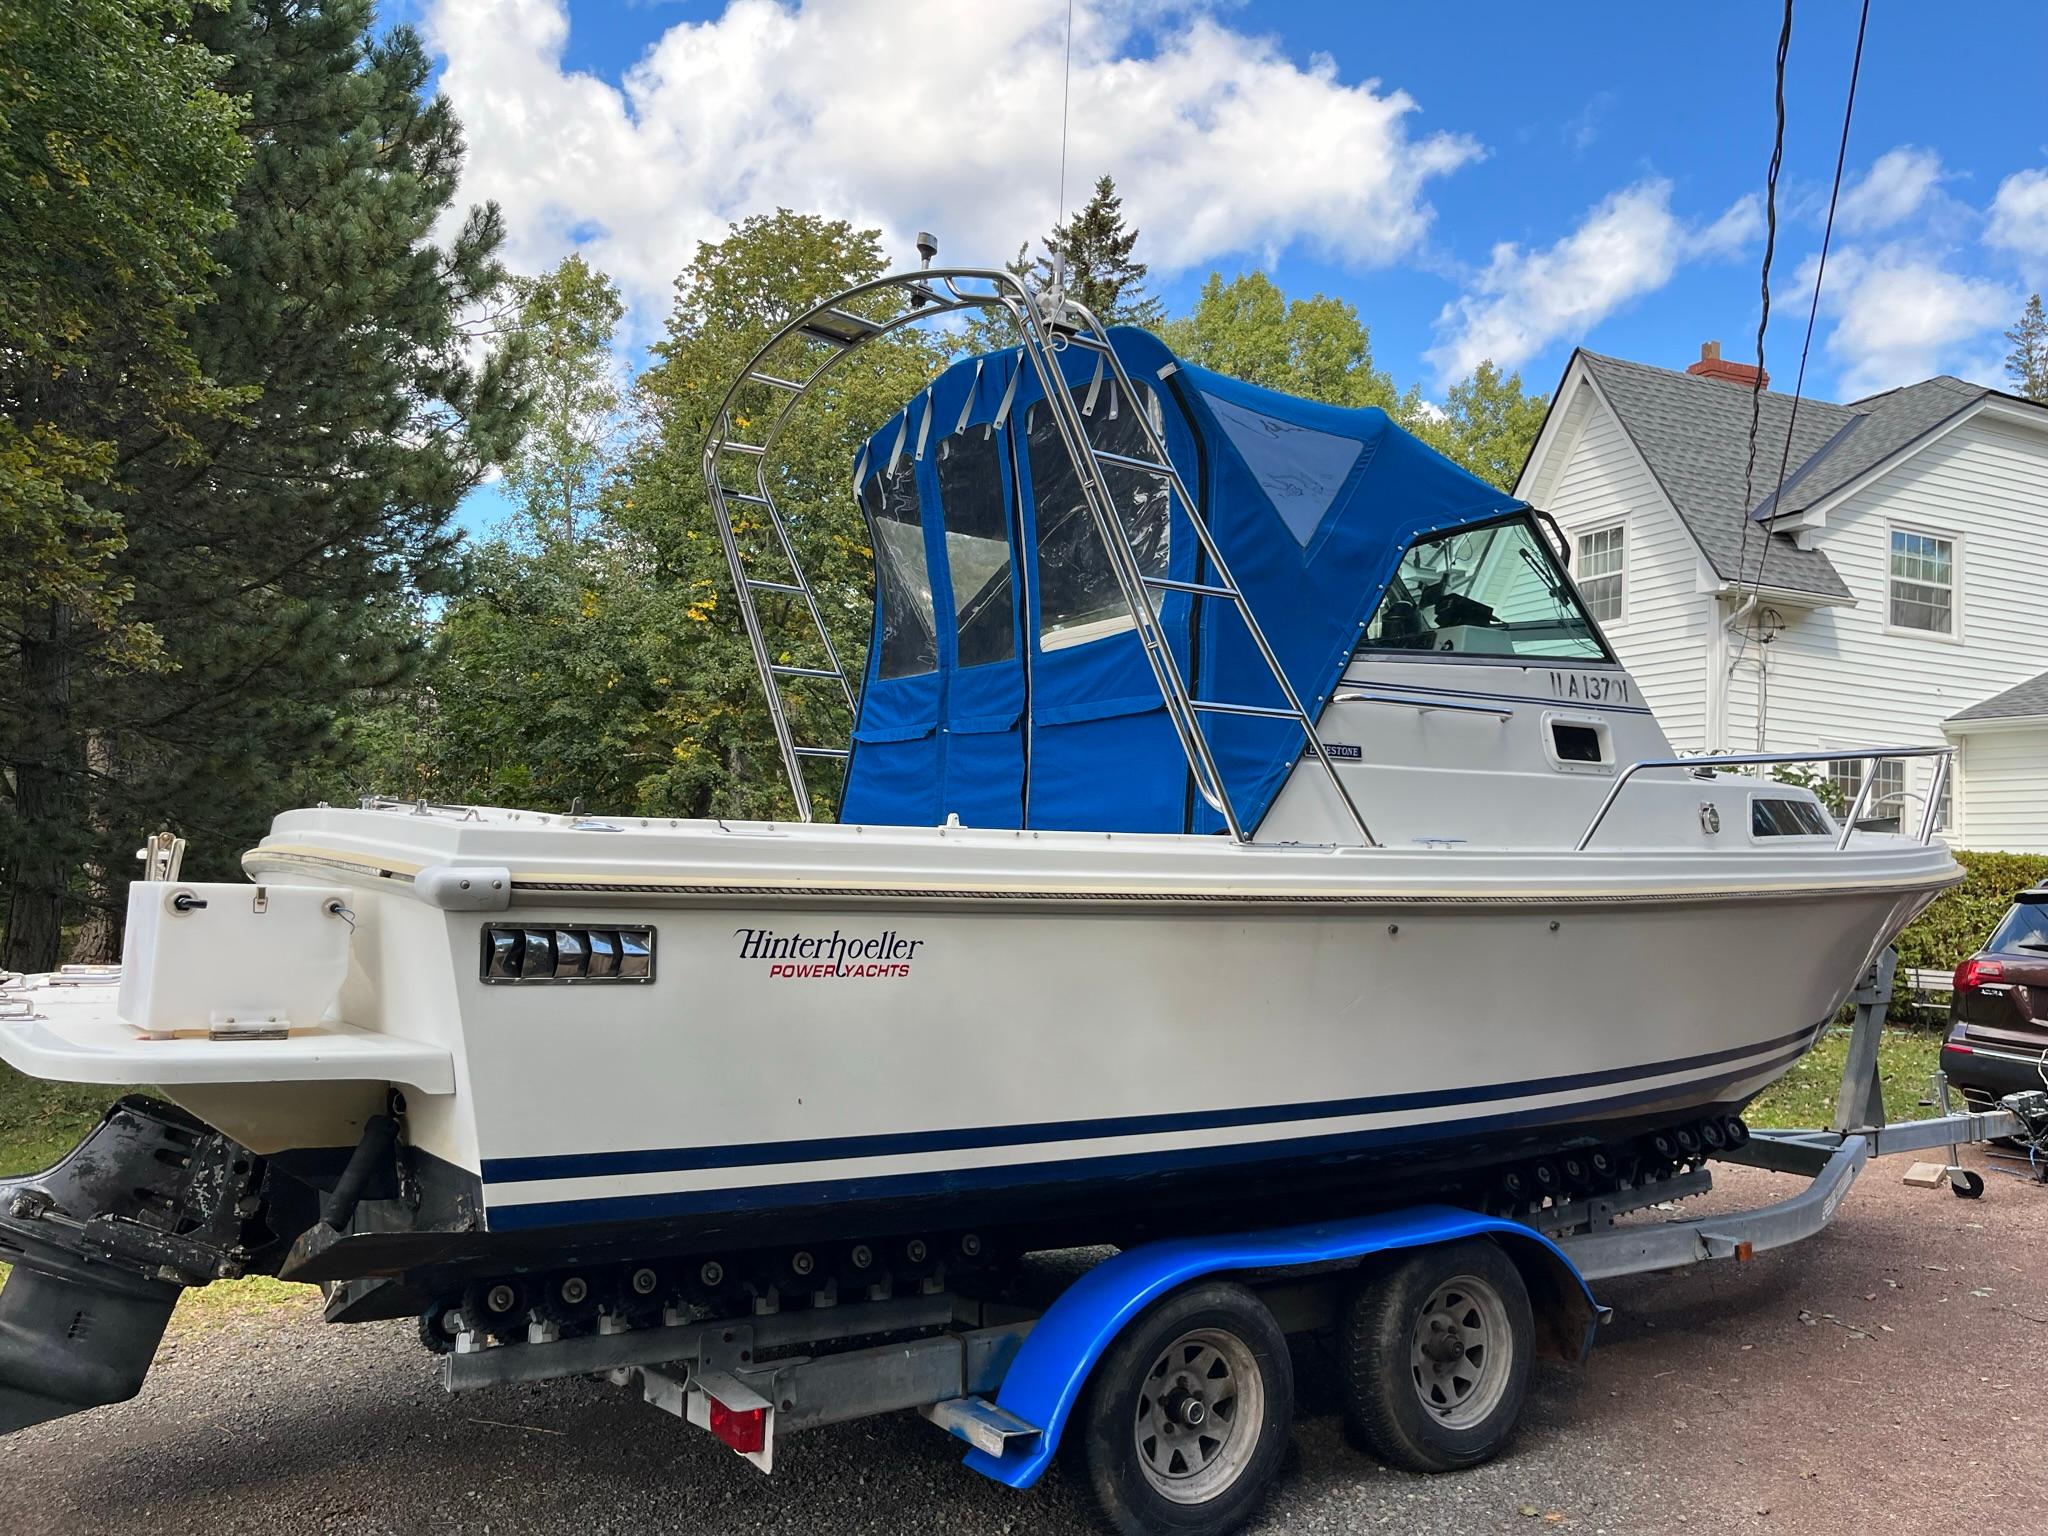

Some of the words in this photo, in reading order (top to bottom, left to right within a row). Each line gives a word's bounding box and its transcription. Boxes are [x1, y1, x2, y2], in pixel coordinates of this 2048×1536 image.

[1309, 745, 1359, 757] LESTONE
[733, 928, 925, 978] Hinterhoeller
[770, 964, 836, 978] POWER
[844, 964, 910, 978] YACHTS
